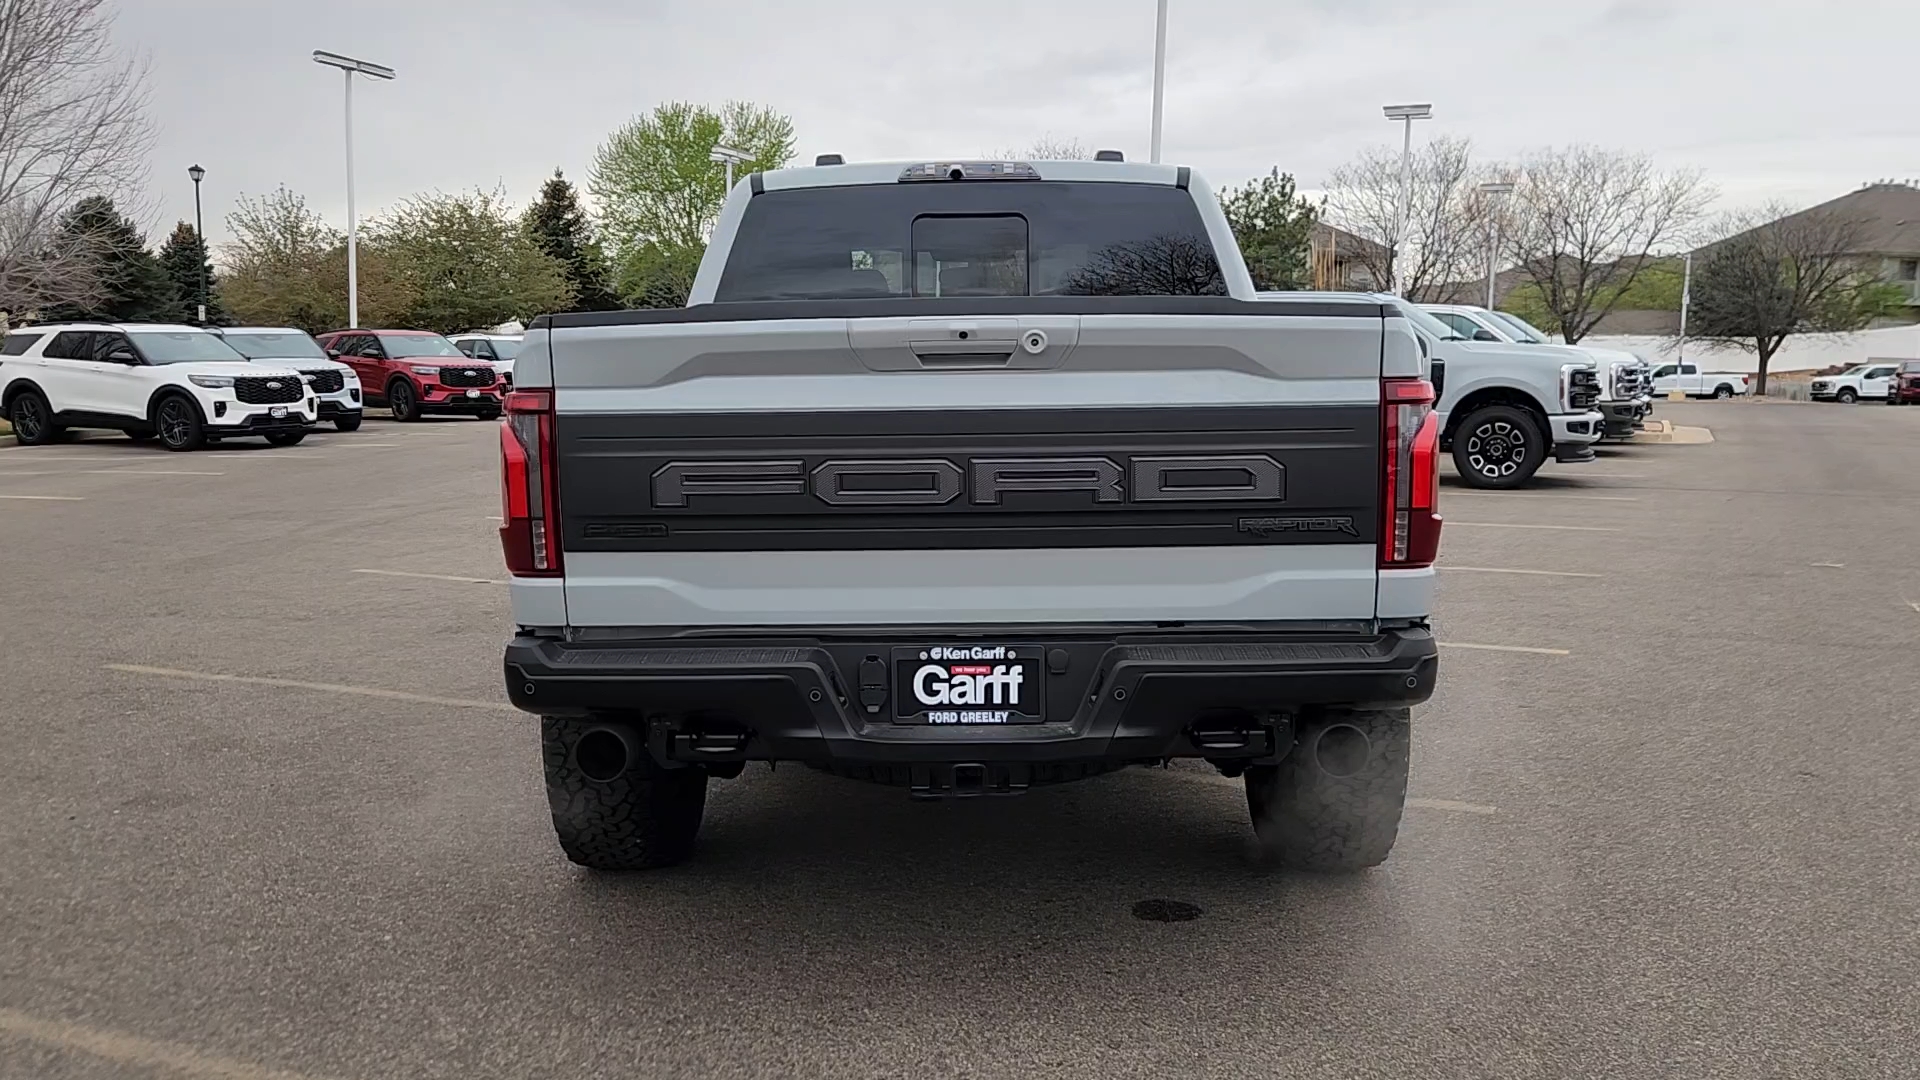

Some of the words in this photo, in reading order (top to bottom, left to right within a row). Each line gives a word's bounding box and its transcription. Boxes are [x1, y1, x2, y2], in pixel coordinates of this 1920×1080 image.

[651, 454, 1287, 508] FORD
[1238, 516, 1360, 537] RAPTOR
[943, 648, 969, 659] Ken
[971, 647, 1005, 659] Garff
[913, 664, 1023, 705] Garff
[928, 712, 958, 723] FORD
[960, 712, 1008, 723] GREELEY
